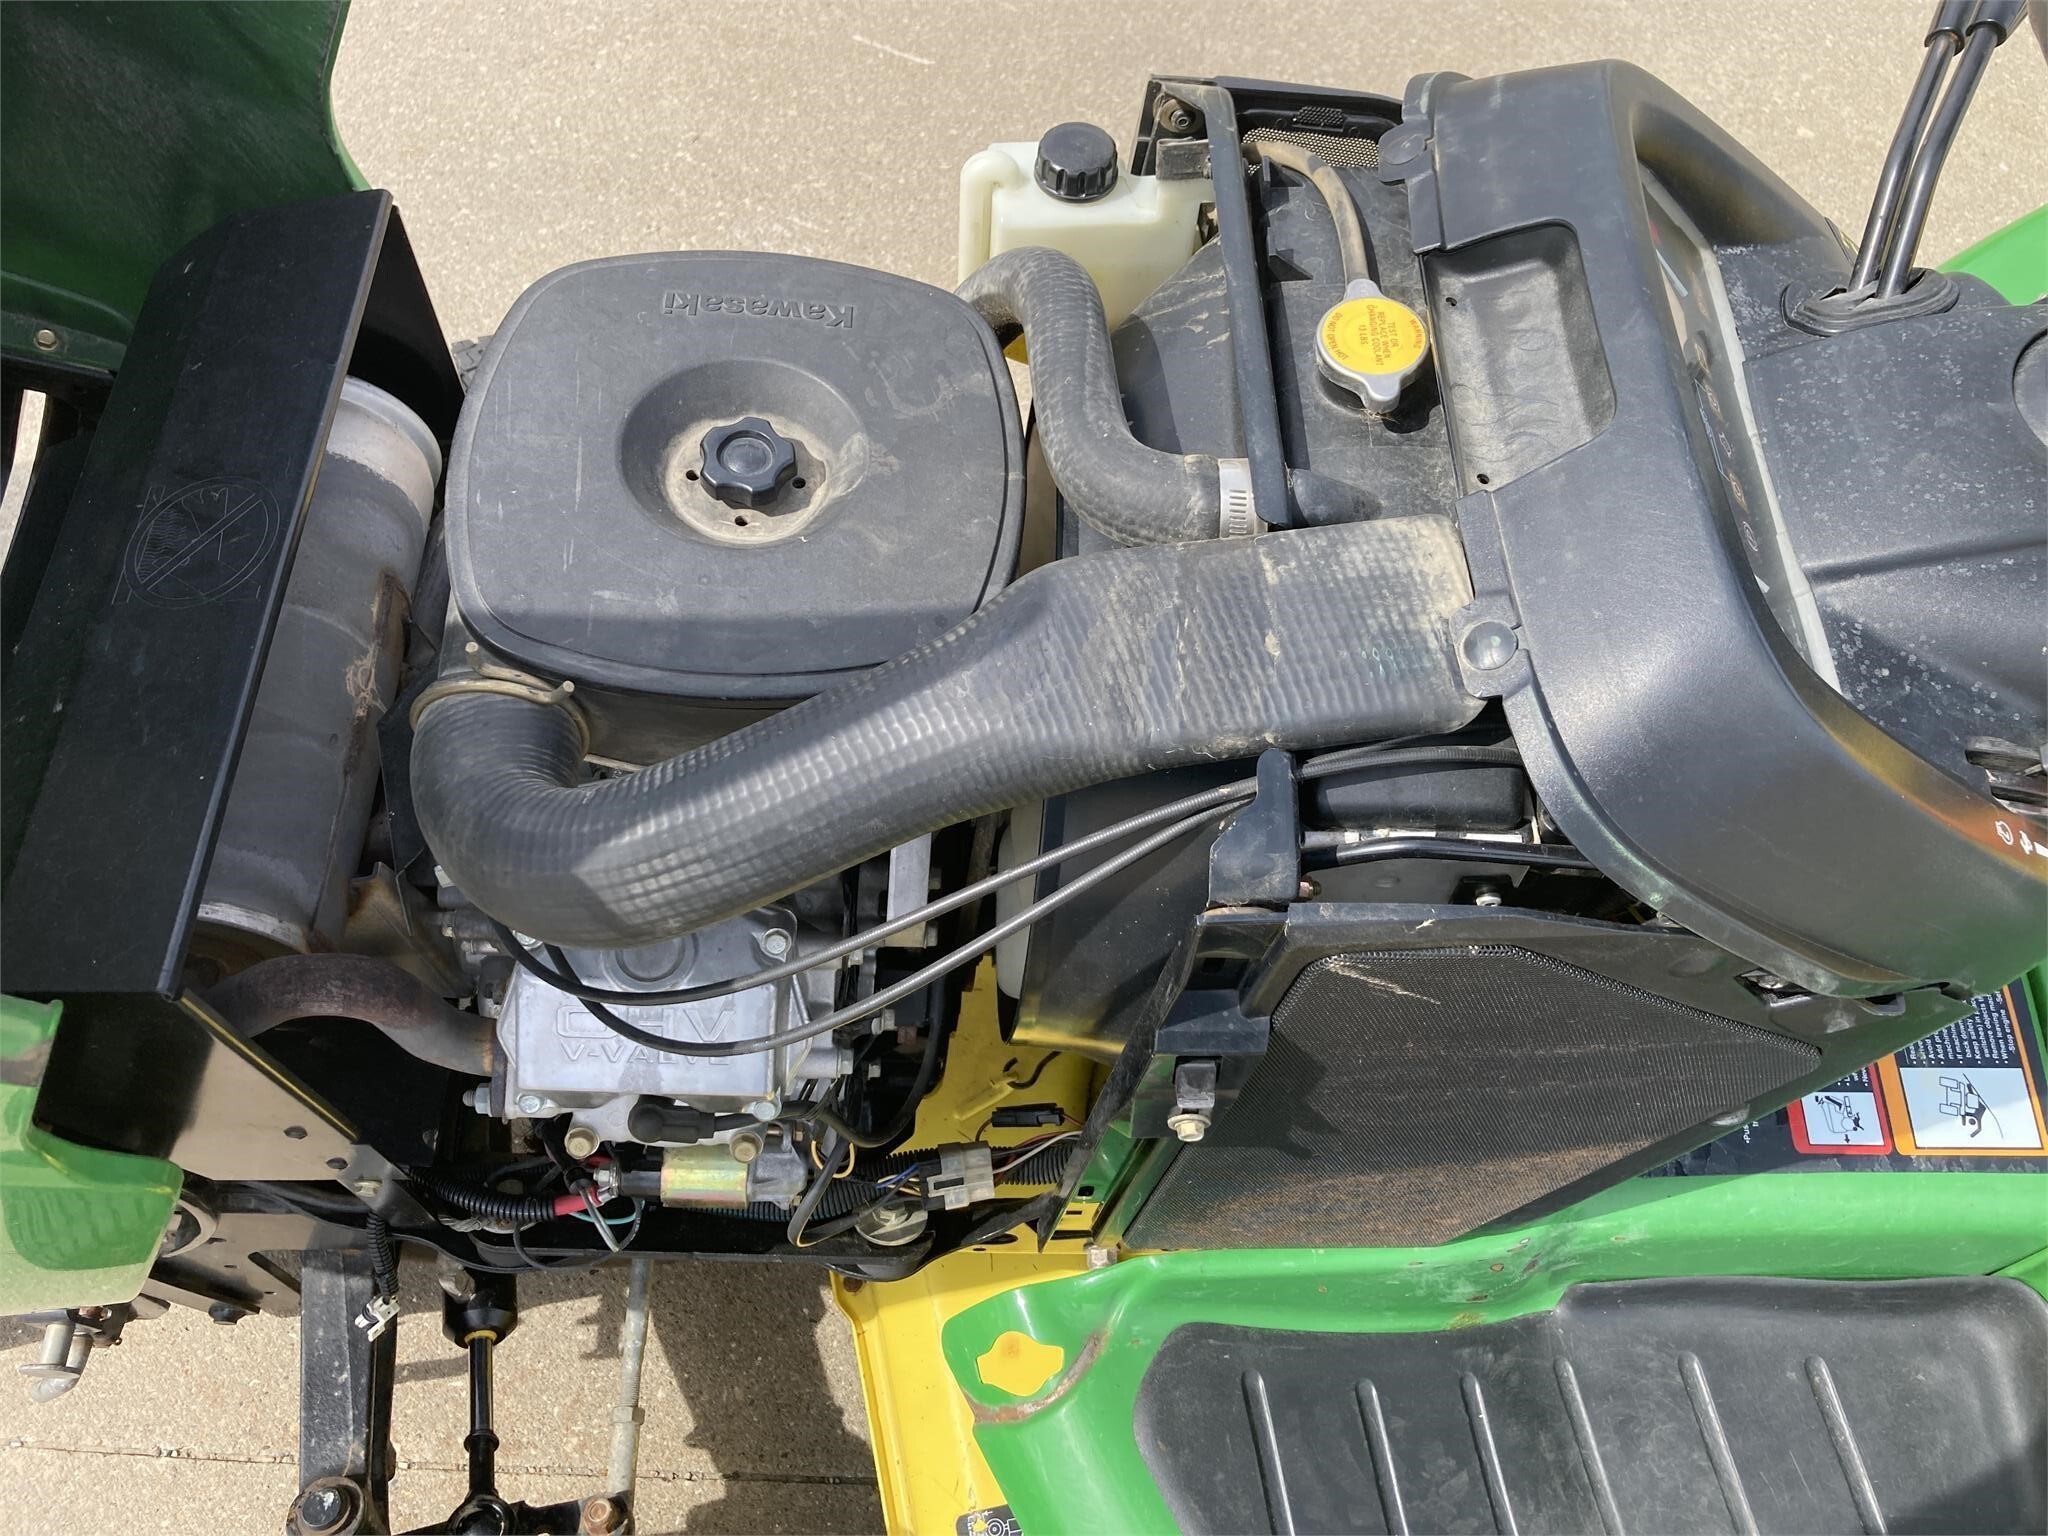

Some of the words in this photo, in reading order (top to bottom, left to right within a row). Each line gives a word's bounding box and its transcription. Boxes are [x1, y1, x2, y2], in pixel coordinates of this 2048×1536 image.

[663, 290, 855, 329] Kawasaki
[1366, 304, 1378, 337] CHANGING
[1327, 321, 1337, 335] NOT
[1377, 311, 1389, 339] REPLACE
[1387, 322, 1398, 337] TEST
[1409, 319, 1424, 350] WARNING
[1326, 333, 1338, 351] OPEN
[1371, 337, 1385, 366] COOLANT
[1381, 340, 1392, 359] WHEN
[1335, 348, 1350, 361] HOT
[556, 1004, 738, 1043] OHV
[1980, 1003, 1992, 1030] objects
[1991, 1012, 2003, 1038] leaving
[2000, 1009, 2011, 1033] engine
[1966, 1018, 1977, 1040] safety
[1925, 1039, 1936, 1059] Avoid
[1936, 1044, 1945, 1060] Add
[1963, 1040, 1972, 1058] back
[1972, 1041, 1982, 1060] Keep
[1987, 1030, 1999, 1059] Remove
[1998, 1039, 2009, 1060] When
